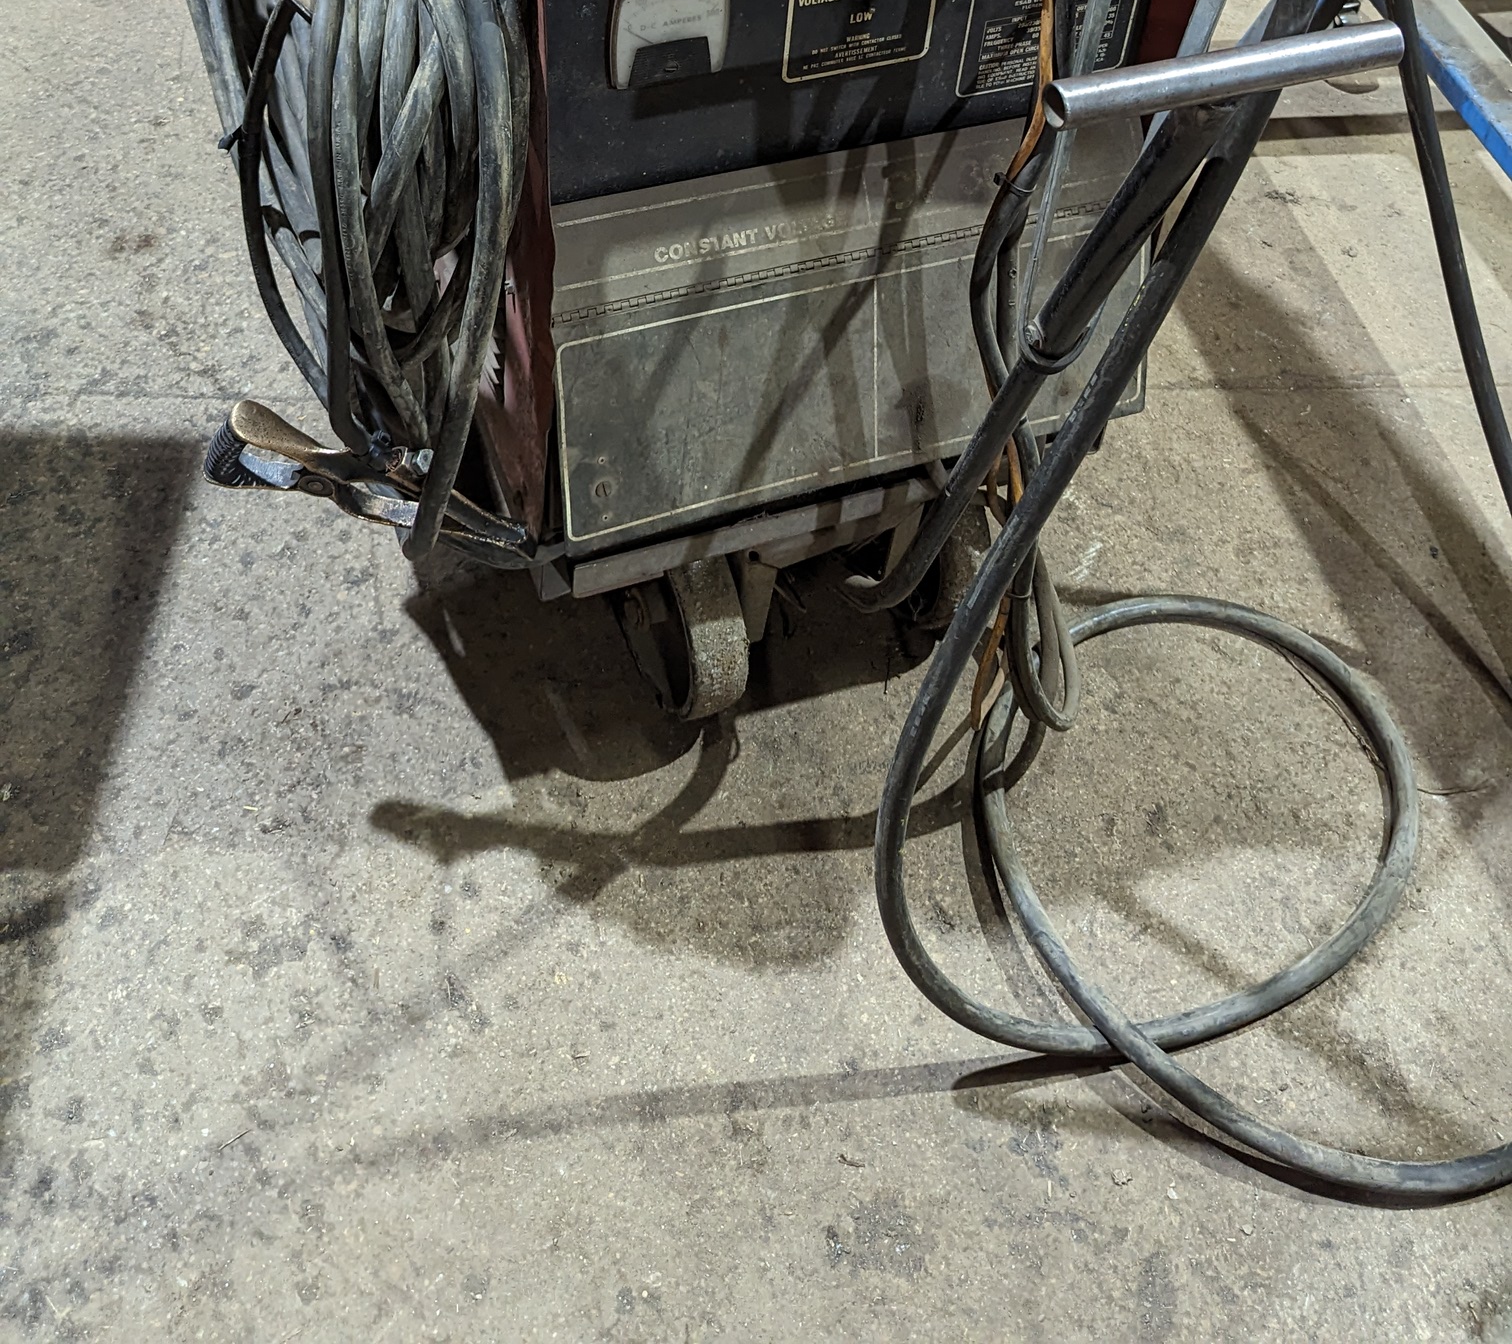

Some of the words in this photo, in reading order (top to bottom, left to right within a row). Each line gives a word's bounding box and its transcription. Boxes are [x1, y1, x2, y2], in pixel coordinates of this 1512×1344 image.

[662, 15, 702, 27] AMPERES
[850, 11, 873, 24] LOW
[830, 44, 847, 52] SWITCH
[861, 36, 885, 46] CONTACTOR
[846, 32, 871, 43] WARNING
[834, 45, 878, 58] AVERTISSEMENT
[653, 228, 759, 263] CONSTANT
